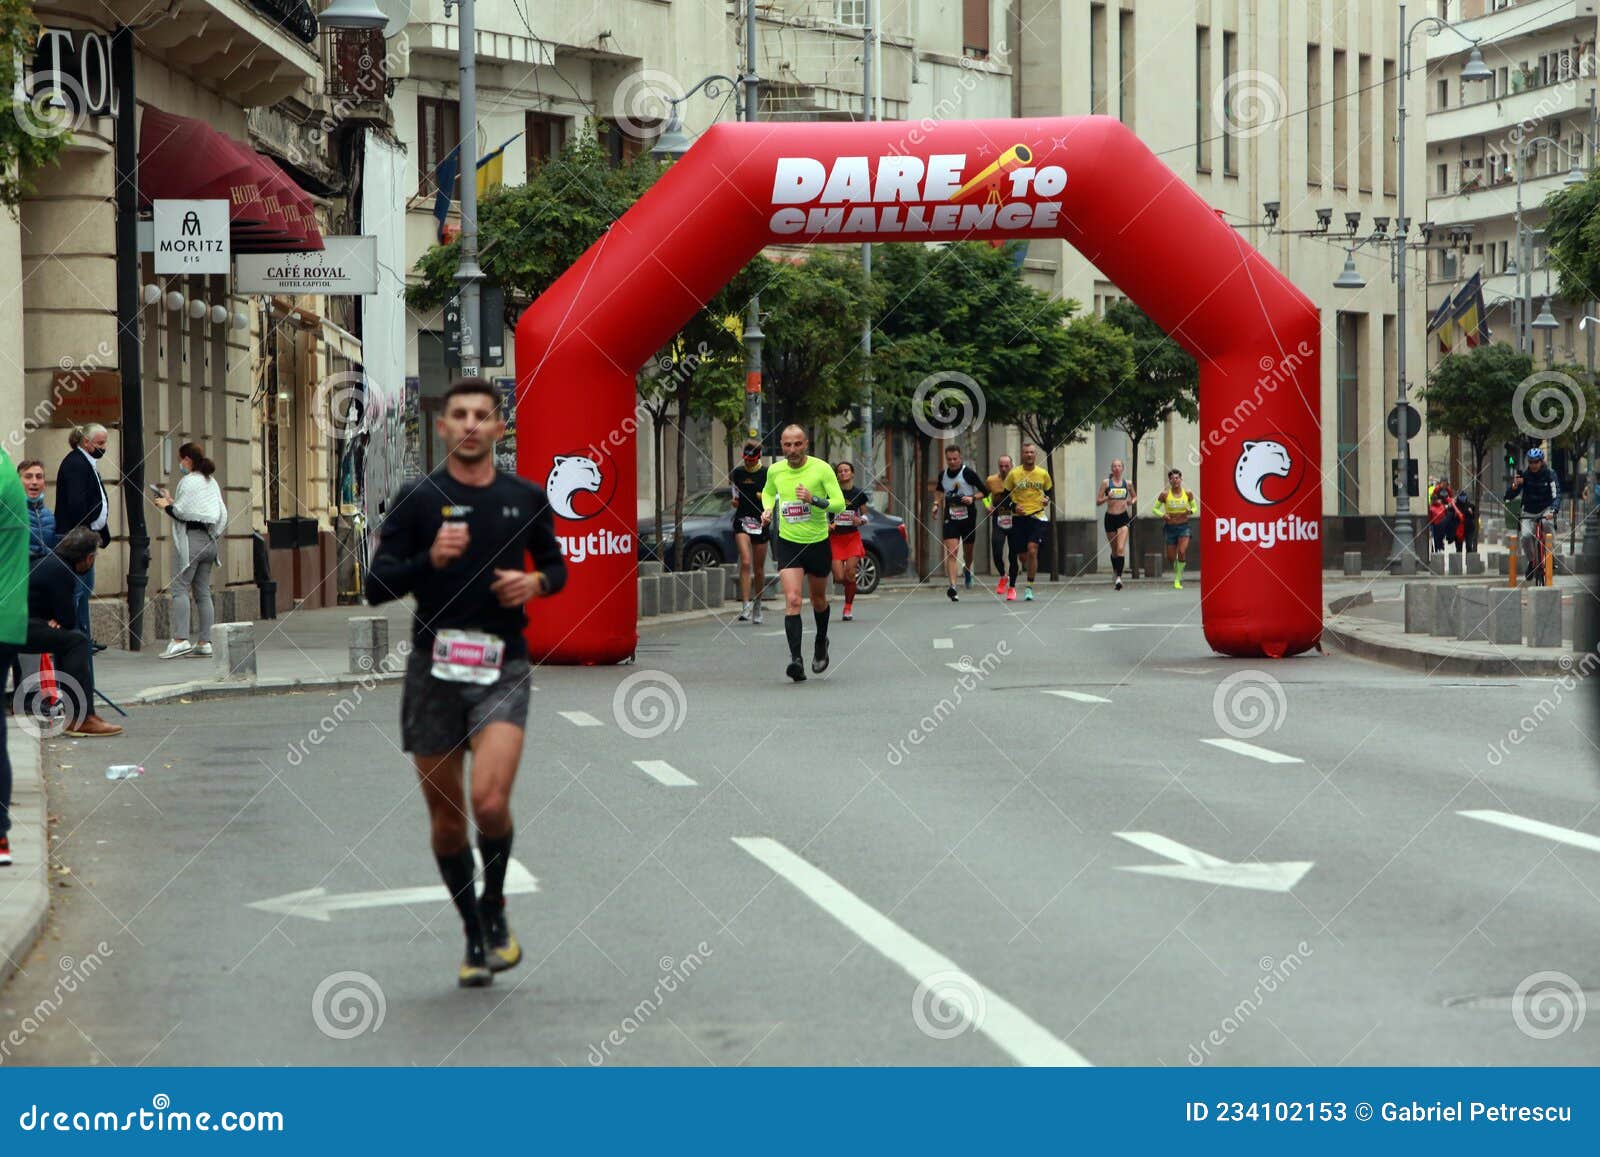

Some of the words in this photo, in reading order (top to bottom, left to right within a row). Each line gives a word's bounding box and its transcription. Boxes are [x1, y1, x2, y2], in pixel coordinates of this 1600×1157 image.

[771, 153, 967, 205] DARE
[1008, 165, 1068, 198] TO
[768, 201, 1062, 235] CHALLENGE
[160, 240, 224, 252] MORITZ
[267, 265, 300, 278] CAFÉ
[304, 267, 346, 279] ROYAL
[1215, 514, 1319, 549] Playtika
